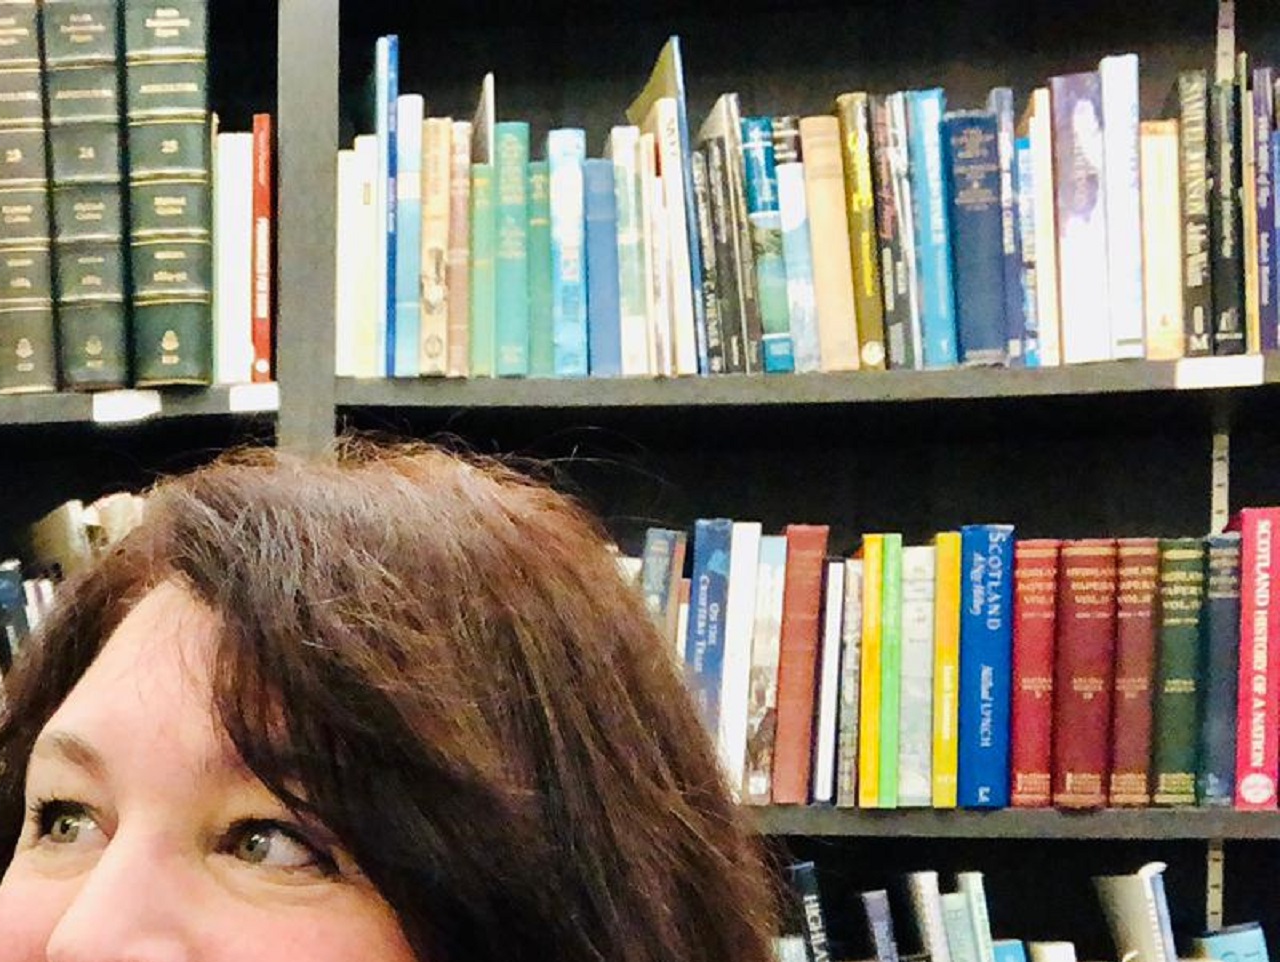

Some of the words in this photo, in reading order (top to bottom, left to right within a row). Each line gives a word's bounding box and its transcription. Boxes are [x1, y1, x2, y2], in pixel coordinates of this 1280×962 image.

[986, 532, 1005, 630] SCOTLAND
[1255, 519, 1271, 606] SCOTLAND
[1253, 609, 1268, 670] HISTORY
[1252, 698, 1266, 710] A
[1253, 674, 1267, 695] OF
[980, 703, 992, 747] LYNCH
[1250, 712, 1265, 768] NATION
